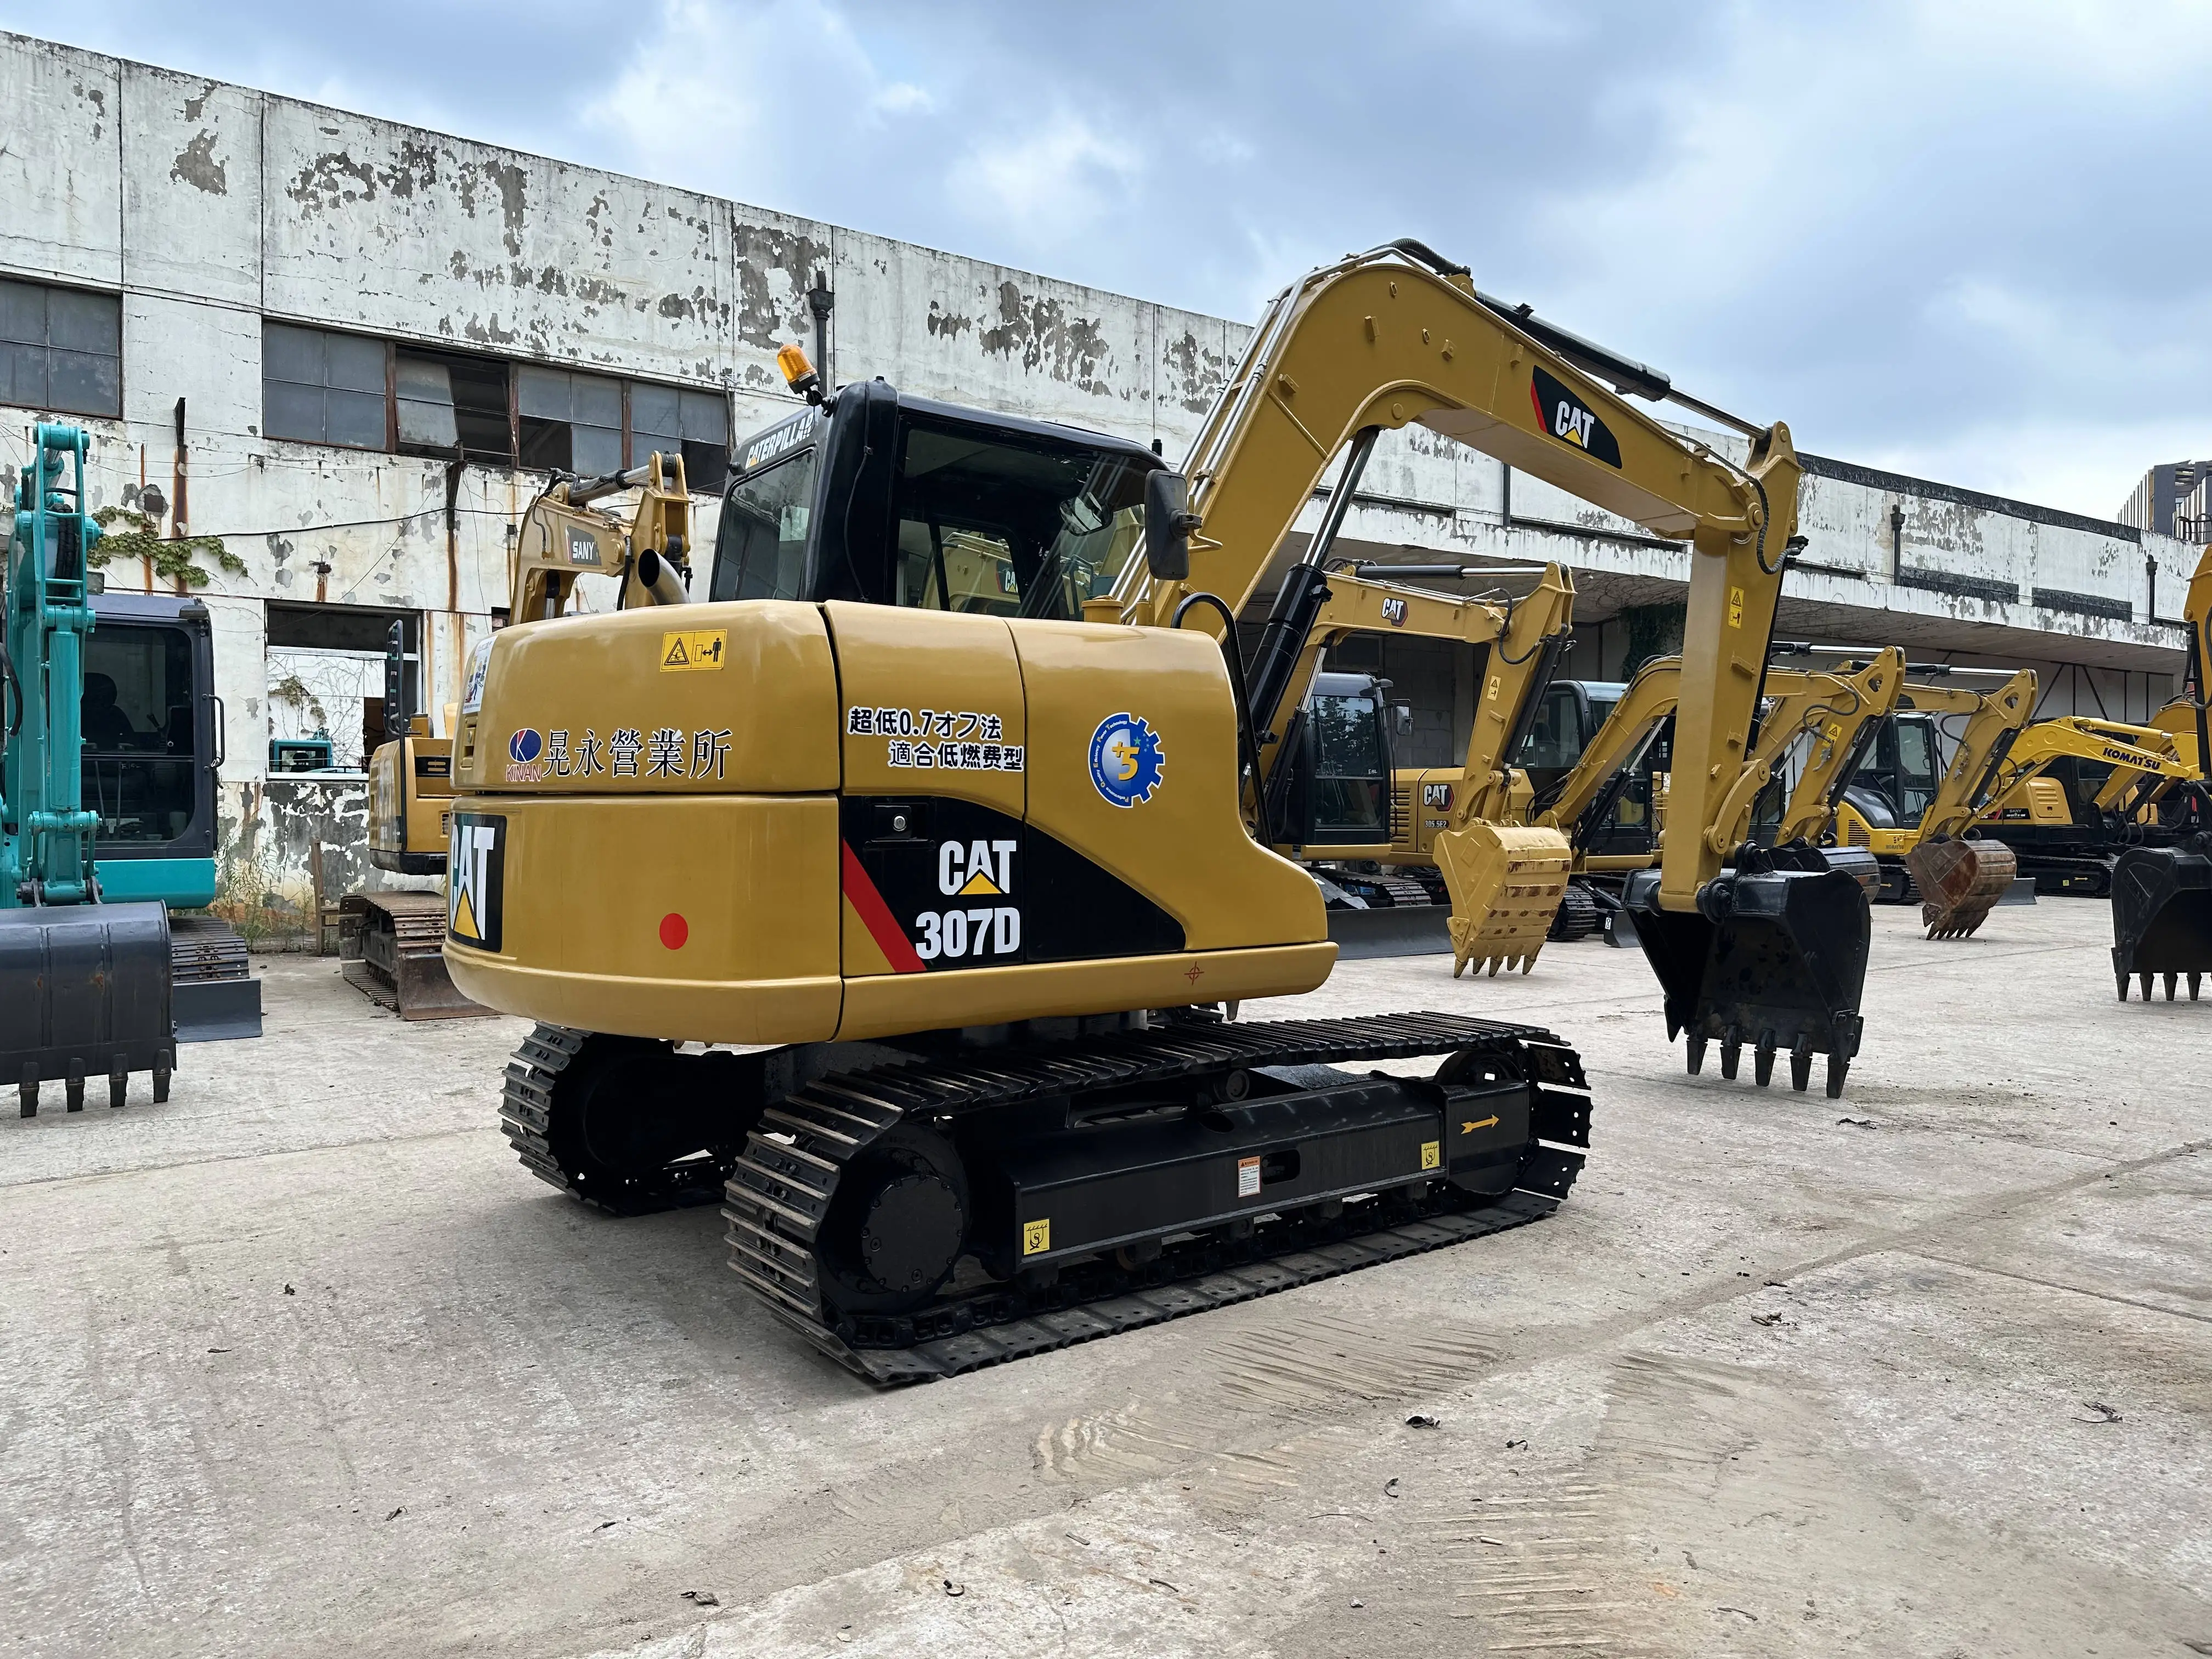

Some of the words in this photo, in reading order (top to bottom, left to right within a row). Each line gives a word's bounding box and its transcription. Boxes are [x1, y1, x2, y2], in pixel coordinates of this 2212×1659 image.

[1555, 400, 1595, 449] CAT
[745, 413, 814, 470] CATERPILLAR
[572, 541, 595, 560] SANY
[1005, 571, 1018, 593] CA
[1381, 598, 1404, 620] CAT
[848, 706, 1002, 741] 超低0.7オフ法
[542, 728, 733, 780] 晃永營業所
[2102, 747, 2162, 770] KOMATSU
[506, 764, 541, 782] KINAN
[1424, 785, 1447, 805] CAT
[1425, 820, 1447, 828] 305.5E2
[450, 824, 495, 940] CAT
[939, 840, 1017, 895] CAT
[915, 907, 1020, 960] 307D
